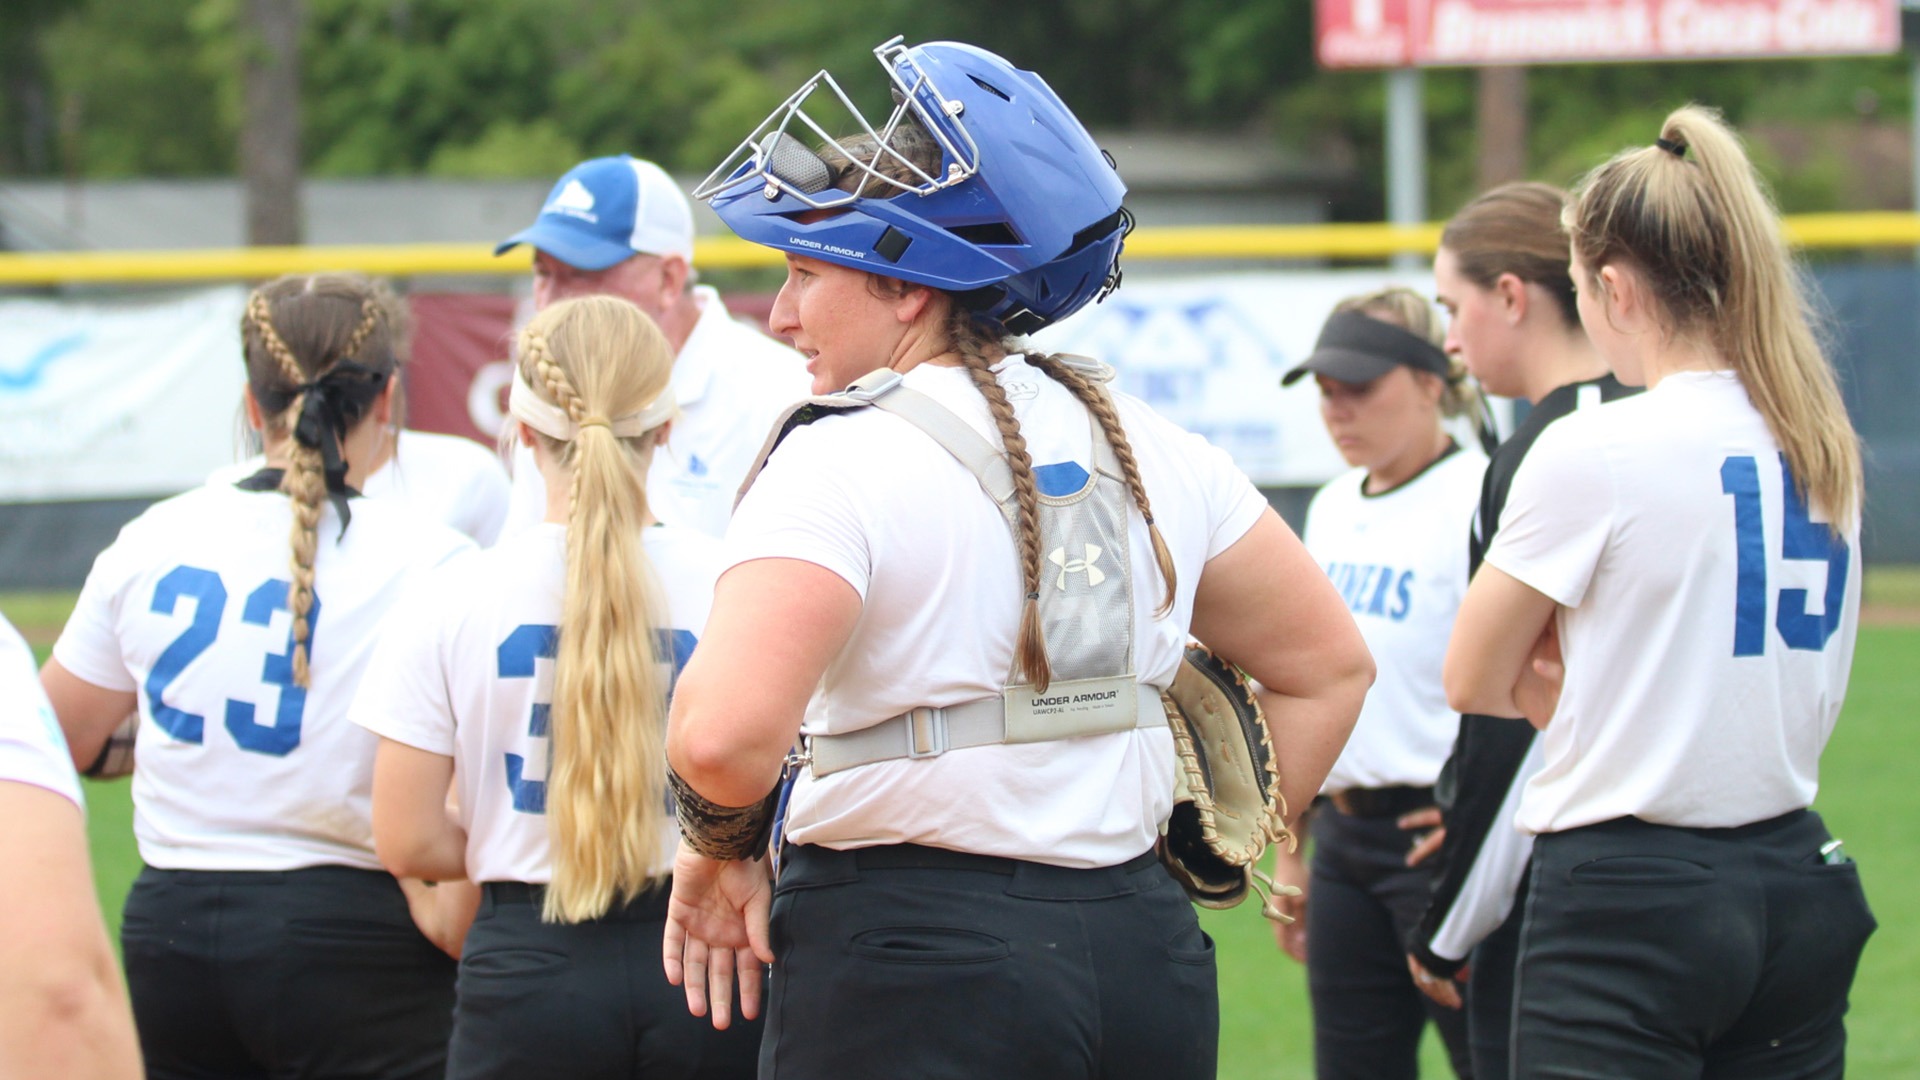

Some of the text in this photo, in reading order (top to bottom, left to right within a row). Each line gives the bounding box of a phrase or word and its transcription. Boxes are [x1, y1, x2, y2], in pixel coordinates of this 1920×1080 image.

[789, 236, 865, 259] UNDER ARMOUR
[1720, 451, 1850, 658] 15
[145, 564, 321, 758] 23
[1031, 690, 1117, 707] UNDER ARMOUR
